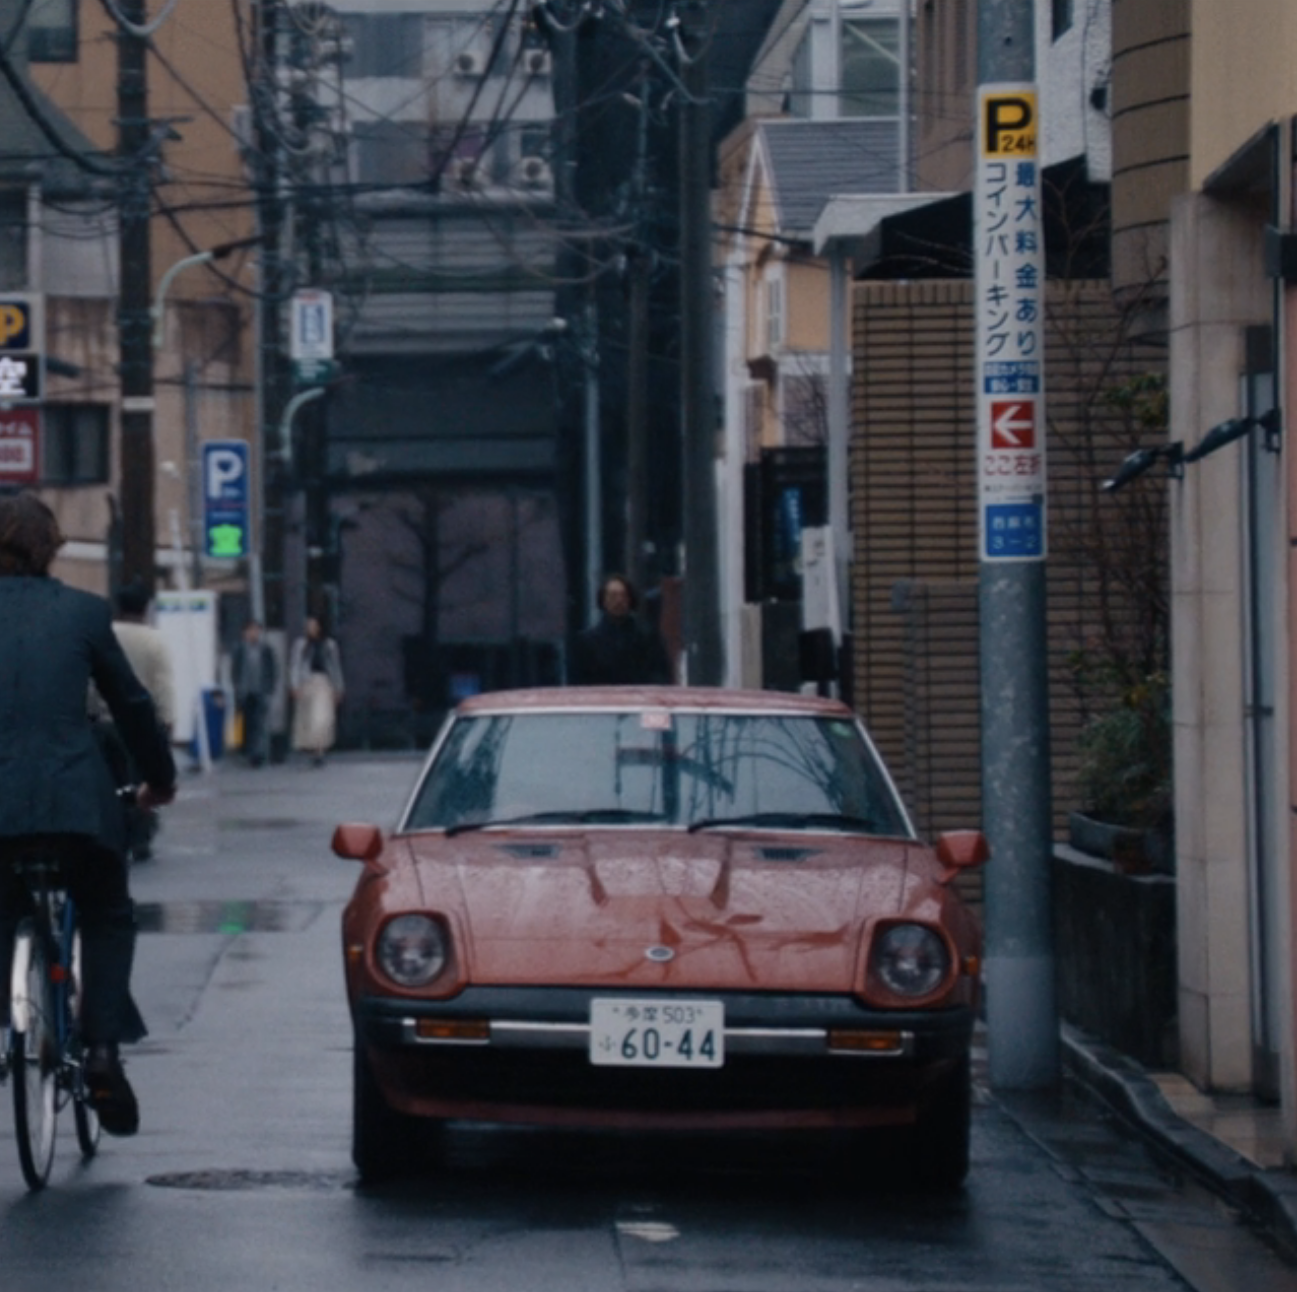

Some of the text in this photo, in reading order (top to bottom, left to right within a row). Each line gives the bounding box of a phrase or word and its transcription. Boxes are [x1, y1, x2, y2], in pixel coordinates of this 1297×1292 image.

[985, 96, 1032, 153] P
[985, 161, 1009, 357] コインパーキング
[1014, 161, 1038, 356] 最大料金あり
[207, 450, 243, 499] P
[662, 1005, 696, 1025] 503
[620, 1027, 716, 1062] 60-44
